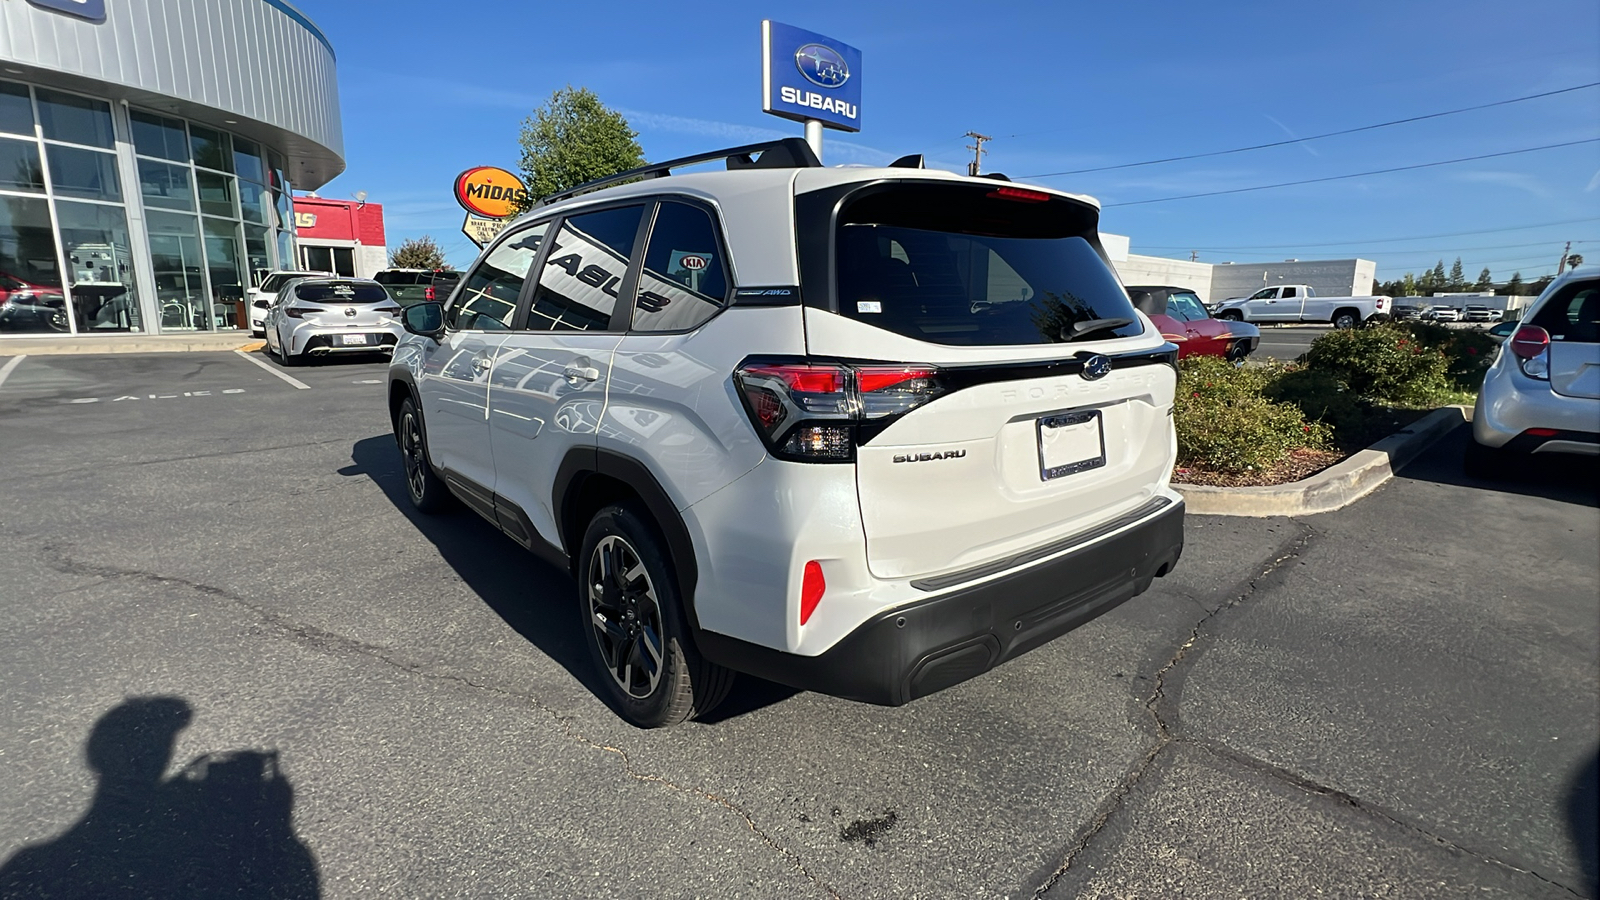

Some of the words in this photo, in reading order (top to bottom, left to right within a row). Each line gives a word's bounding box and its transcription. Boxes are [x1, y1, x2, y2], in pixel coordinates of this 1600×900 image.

[781, 86, 857, 119] SUBARU
[466, 181, 527, 202] MIDAS
[686, 258, 703, 268] KIA
[1001, 372, 1156, 402] FORESTER
[893, 449, 966, 463] SUBARU
